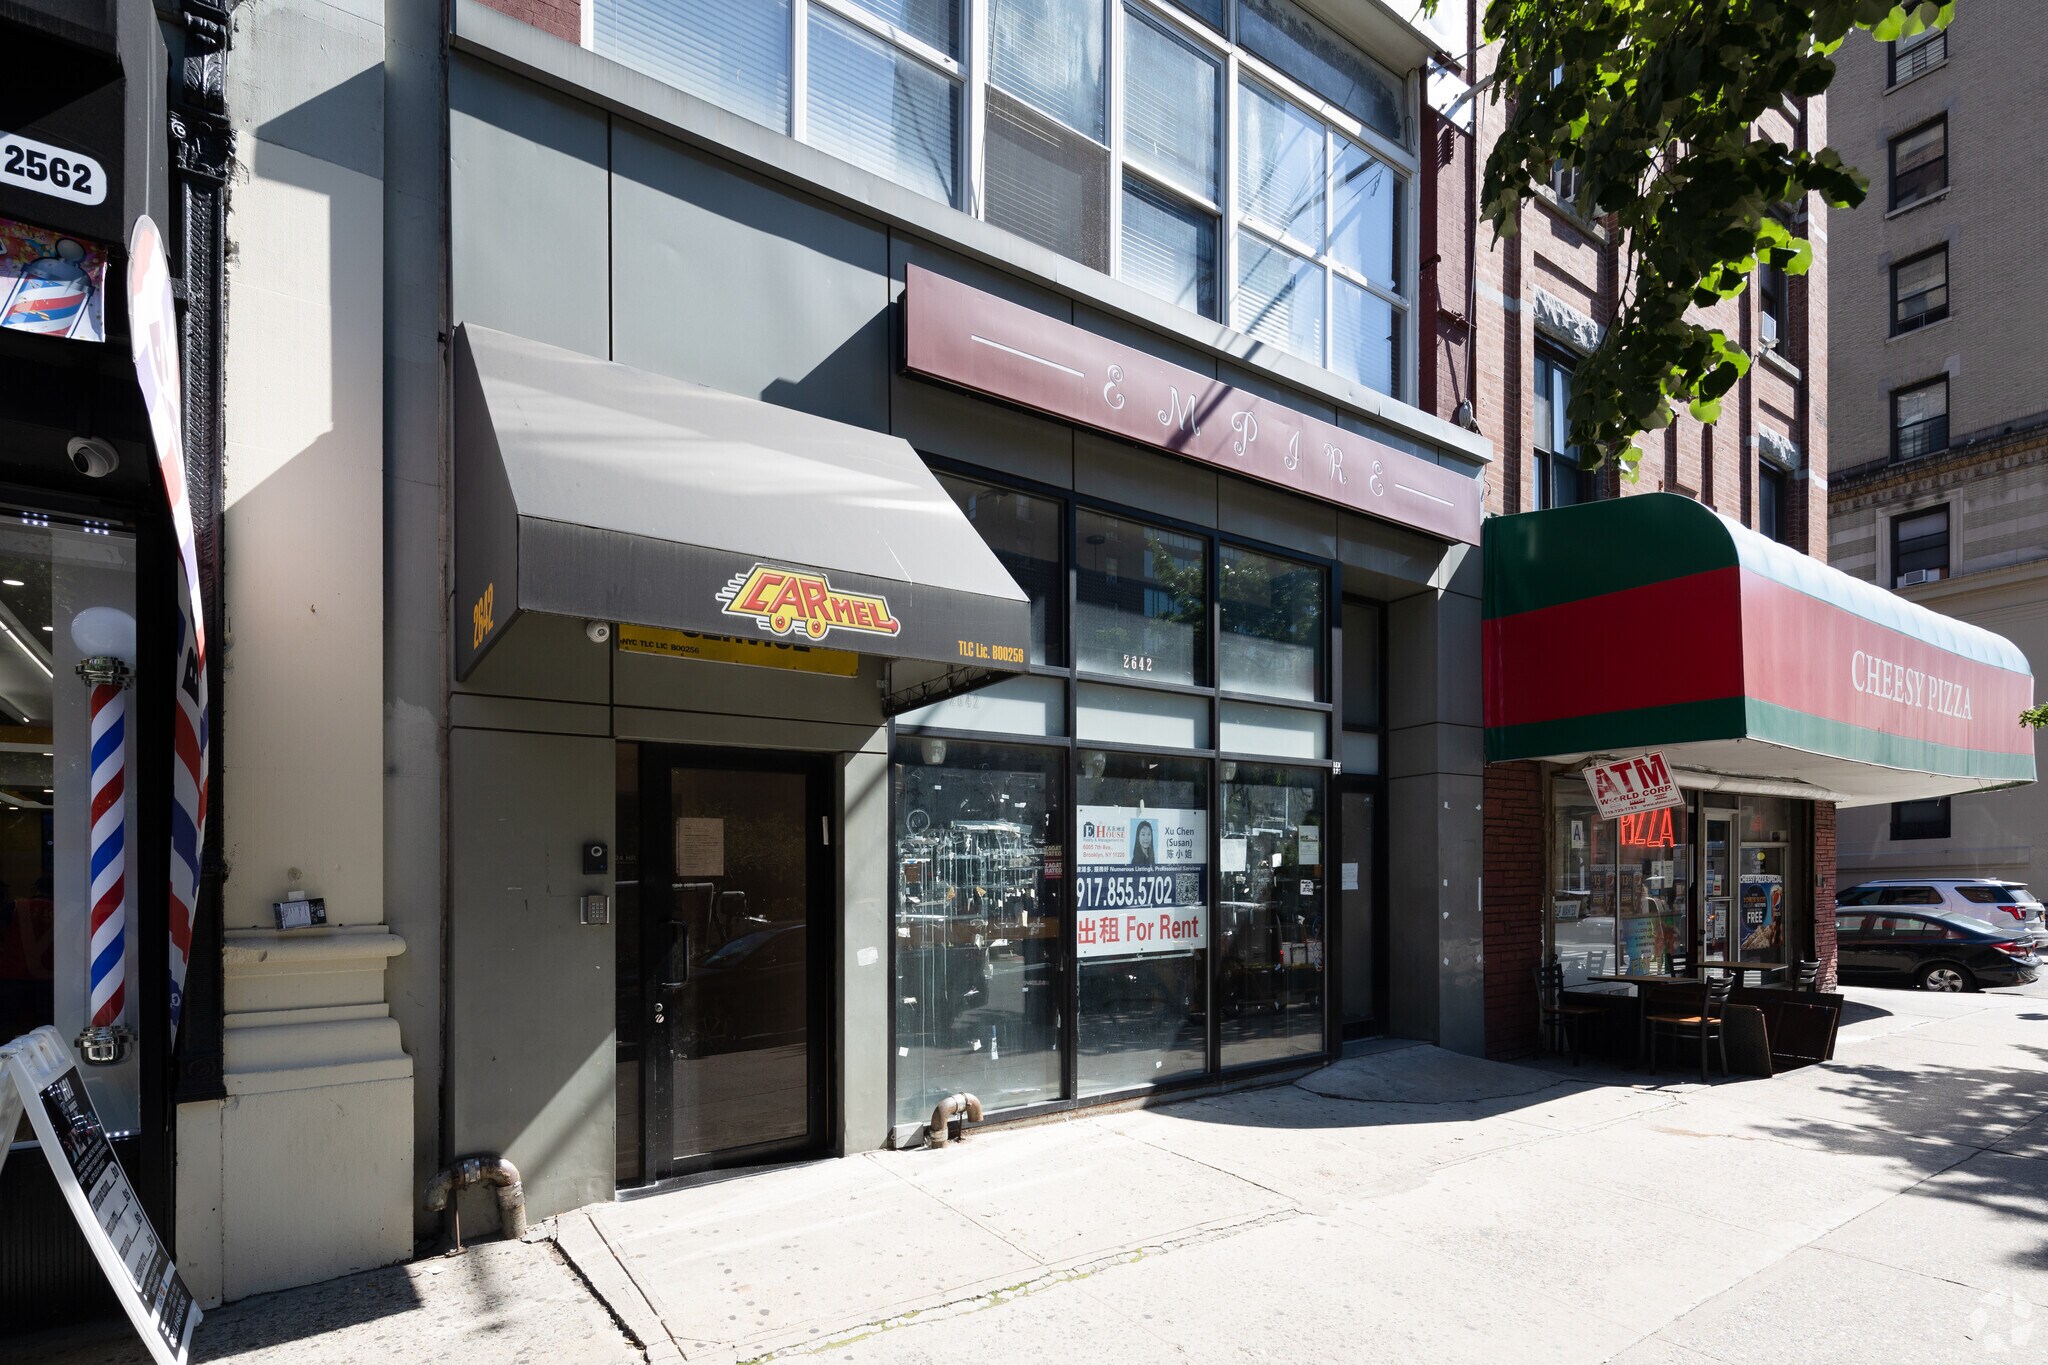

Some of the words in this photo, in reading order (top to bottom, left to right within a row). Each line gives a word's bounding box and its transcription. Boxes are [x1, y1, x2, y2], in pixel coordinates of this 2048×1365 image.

[4, 142, 92, 195] 2562
[473, 583, 495, 650] 2642
[743, 574, 898, 635] CARMEL
[622, 638, 637, 646] NYC
[640, 640, 654, 648] TLC
[656, 642, 668, 650] LIC
[958, 640, 974, 657] TLC
[976, 642, 990, 659] Lic.
[1123, 654, 1153, 672] 2642
[1851, 650, 1926, 708] CHEESY
[1927, 676, 1973, 720] PIZZA
[1595, 754, 1671, 799] ATM
[1642, 785, 1673, 797] CORP.
[1165, 827, 1175, 836] Xu
[1176, 827, 1195, 836] Chen
[1620, 807, 1674, 847] PIZZA
[1166, 838, 1193, 848] (Susan)
[1077, 875, 1172, 907] 917.855.5702
[1078, 916, 1120, 945] 出租
[1126, 914, 1154, 941] For
[1160, 914, 1199, 940] Rent
[1747, 912, 1763, 924] FREE
